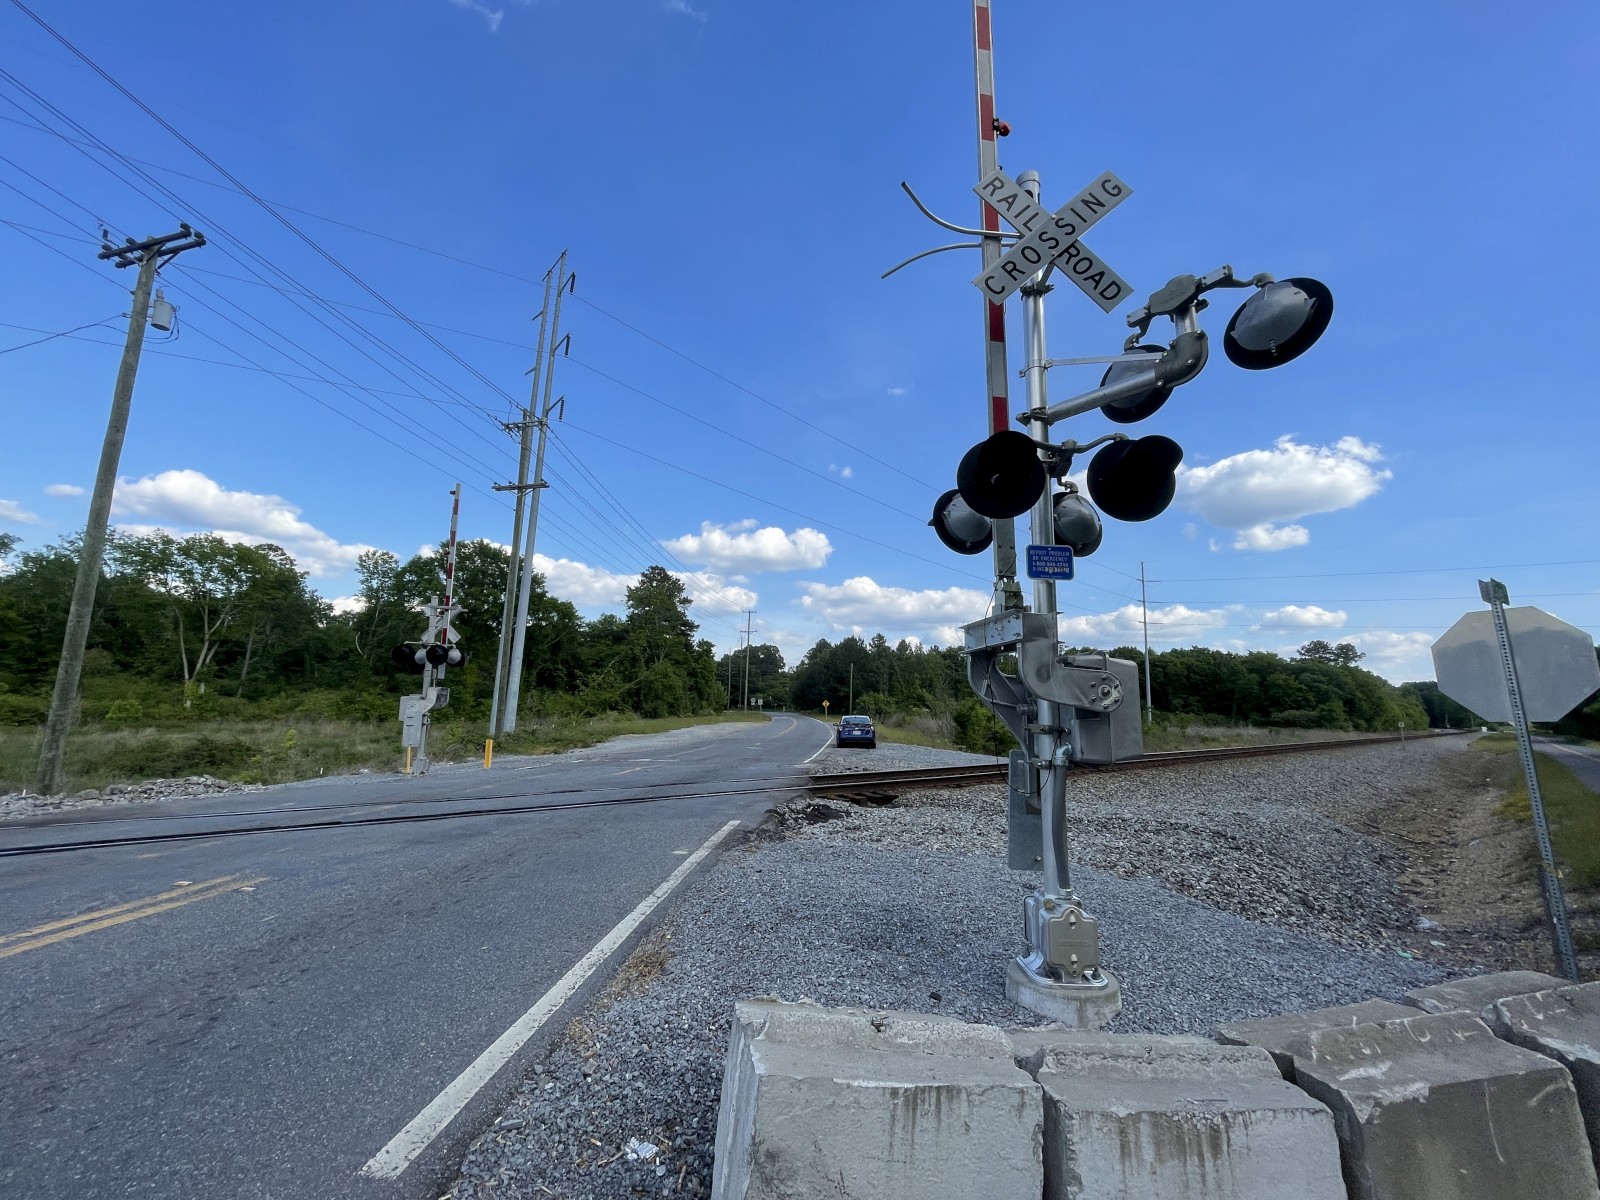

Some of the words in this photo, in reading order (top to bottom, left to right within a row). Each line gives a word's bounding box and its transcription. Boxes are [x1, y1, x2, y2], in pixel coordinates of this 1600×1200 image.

[983, 176, 1039, 232] RAIL
[1063, 243, 1122, 301] ROAD
[984, 179, 1122, 295] CROSSING
